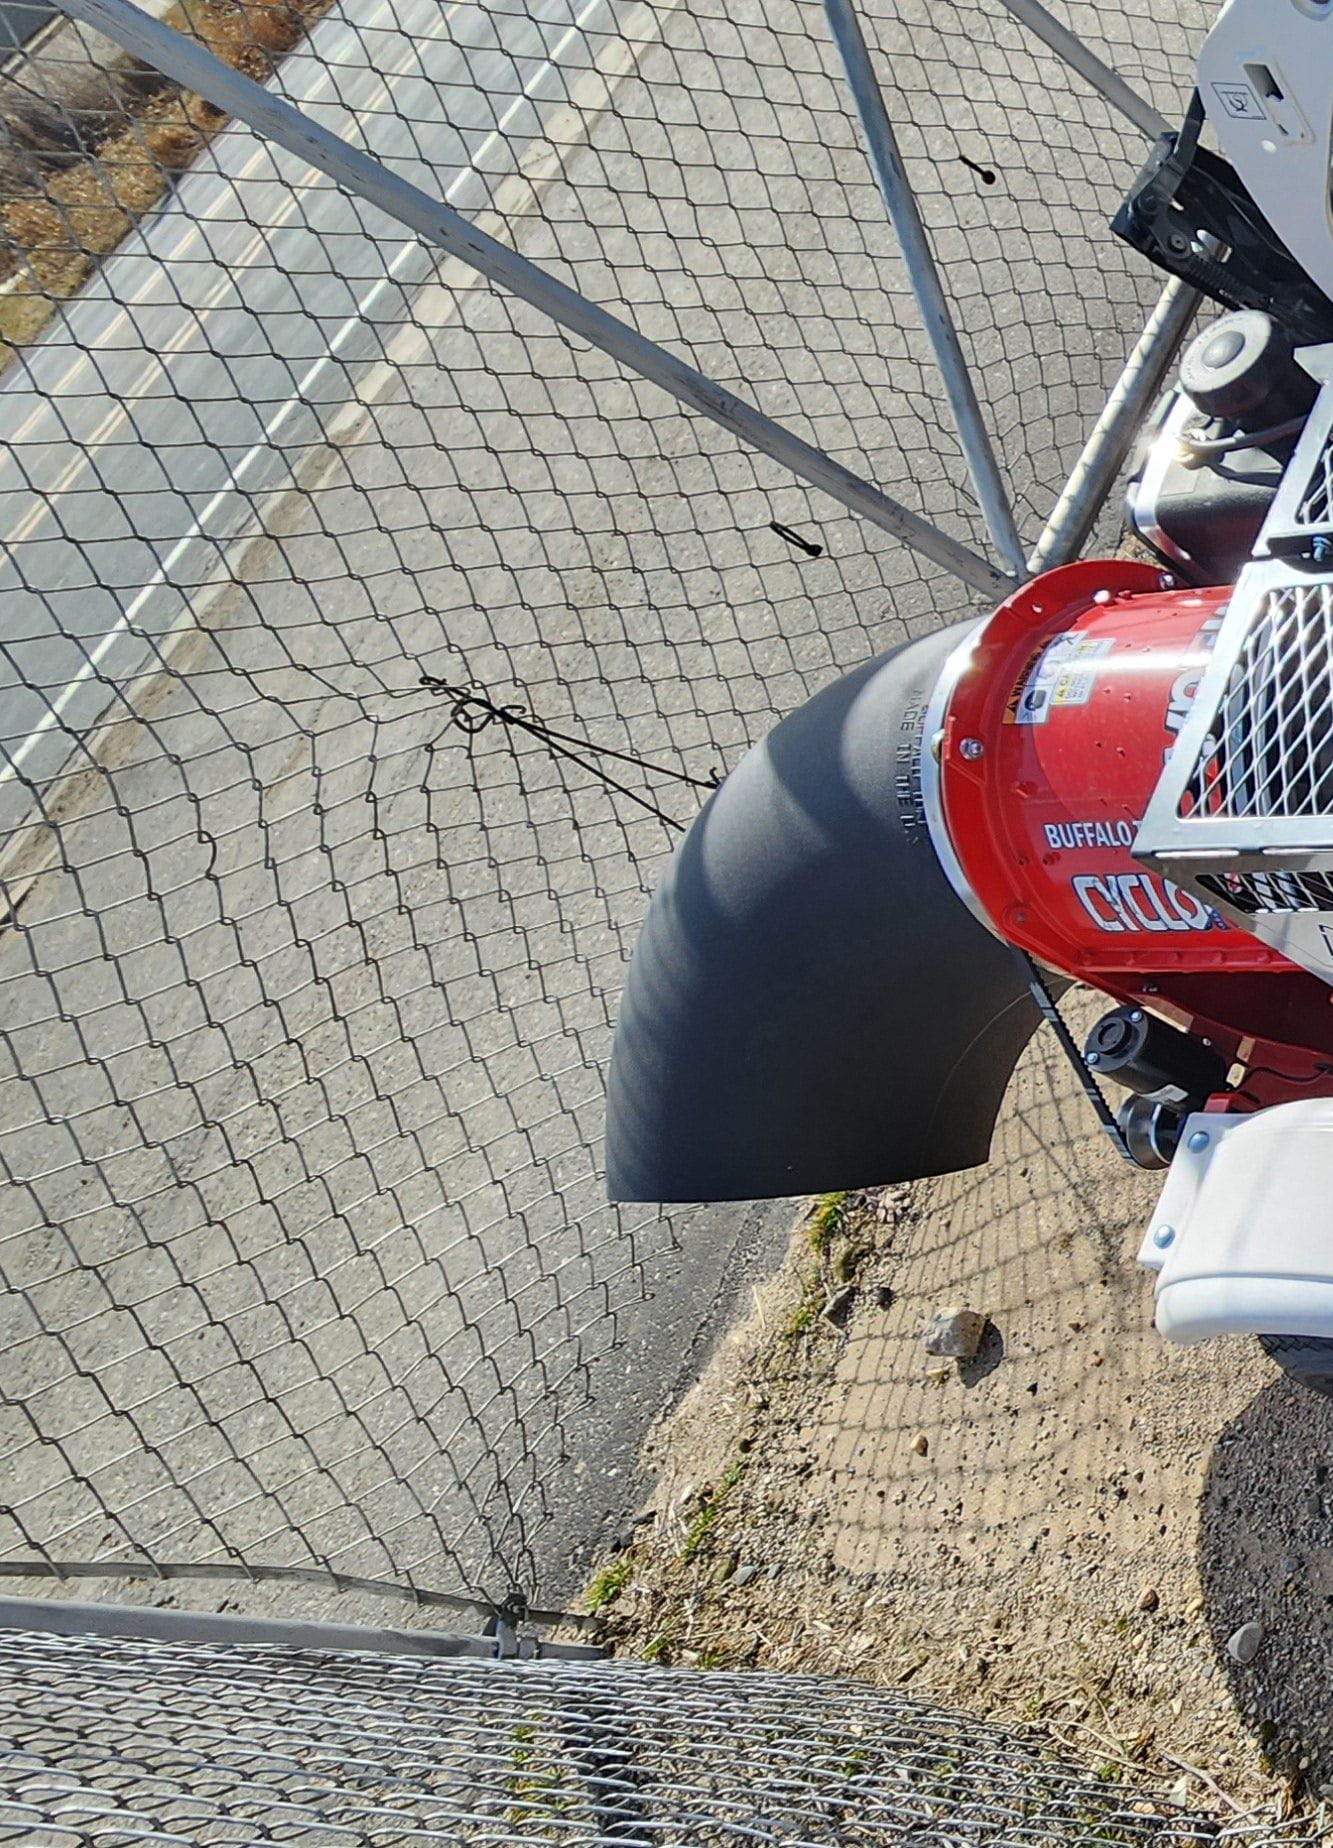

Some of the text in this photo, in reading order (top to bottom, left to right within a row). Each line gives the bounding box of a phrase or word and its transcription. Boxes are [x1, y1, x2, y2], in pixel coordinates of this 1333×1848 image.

[900, 688, 923, 731] MADE
[896, 743, 912, 764] IN
[1044, 820, 1132, 848] BUFFALO
[1073, 874, 1213, 930] CYCLO
